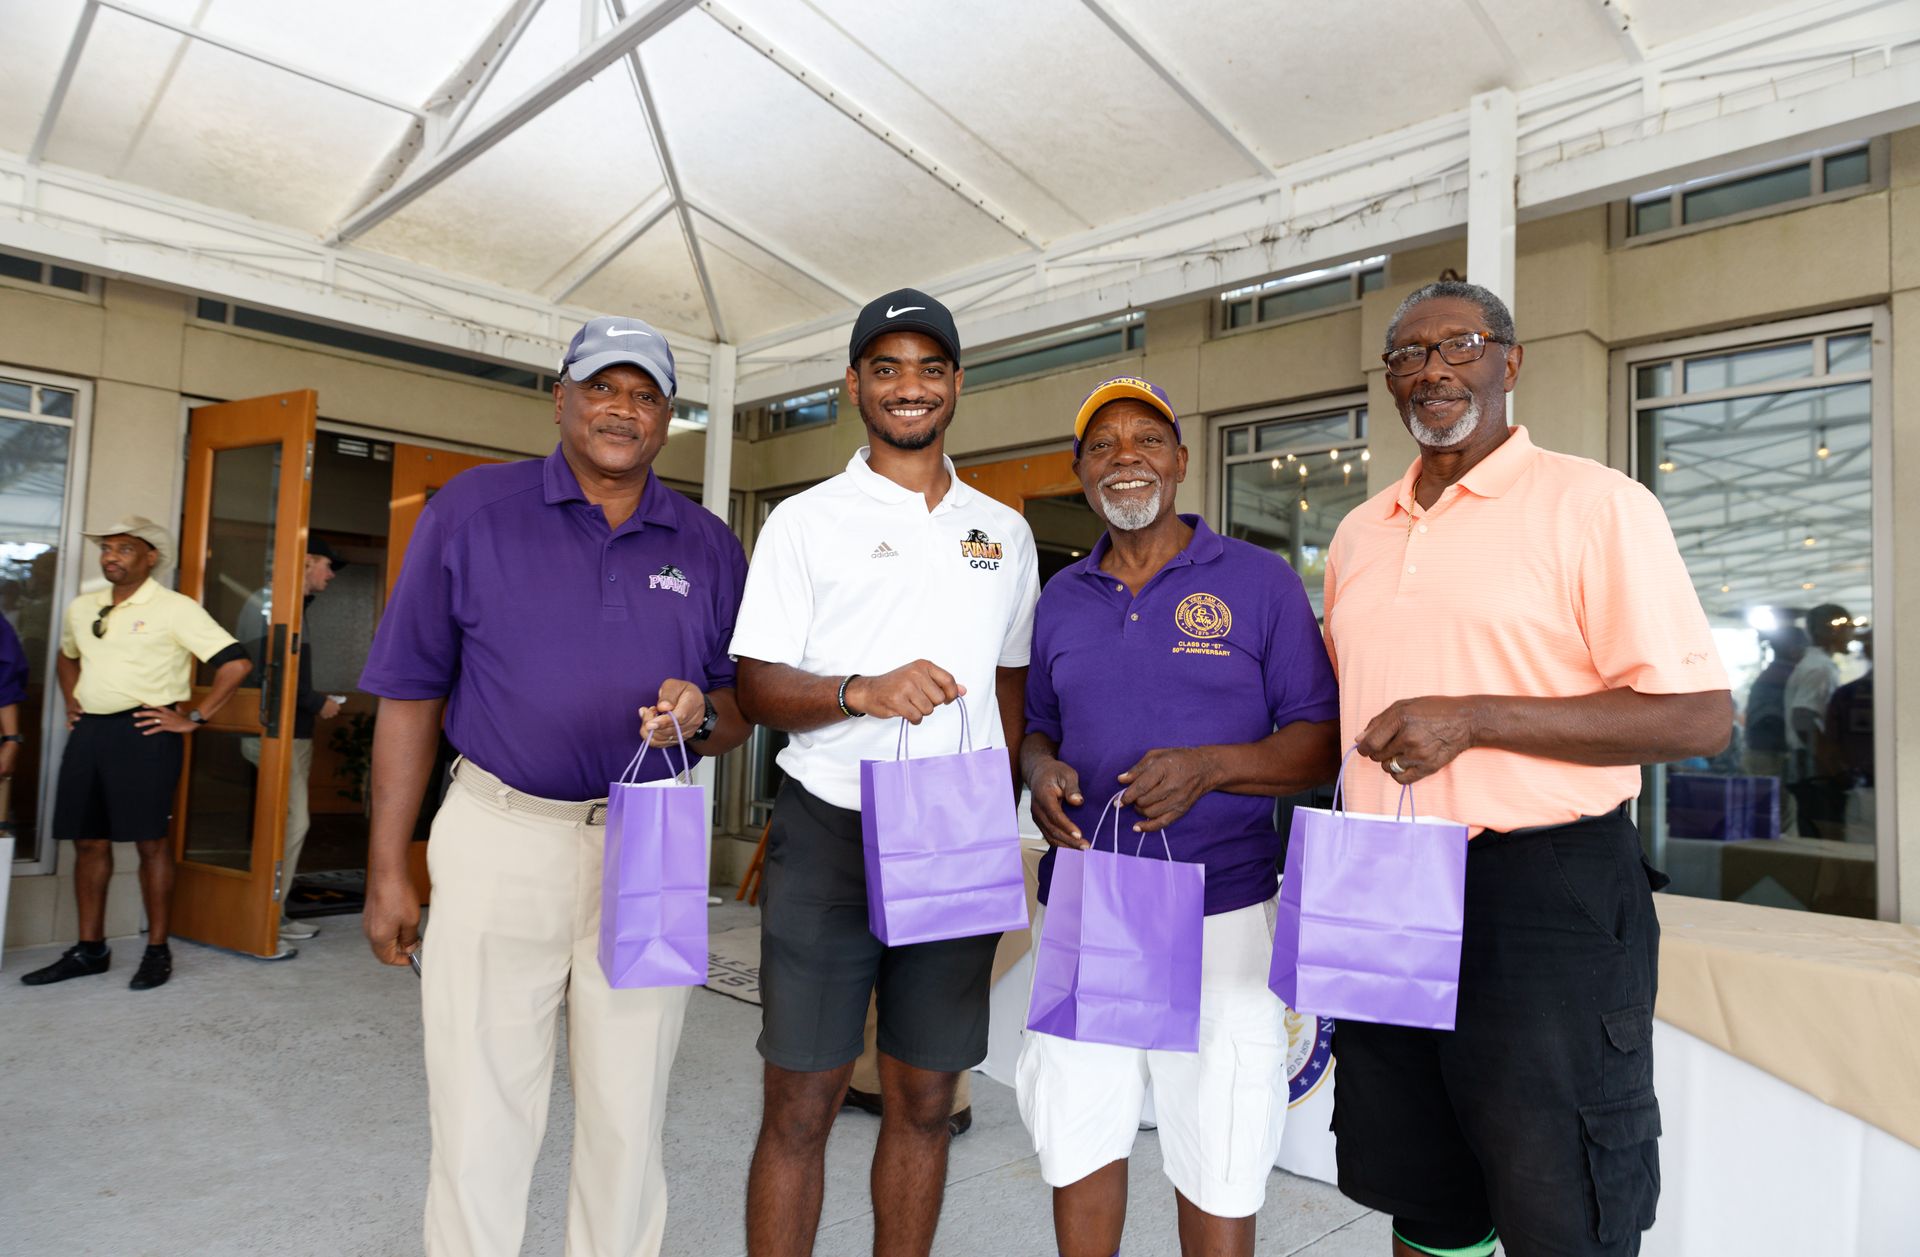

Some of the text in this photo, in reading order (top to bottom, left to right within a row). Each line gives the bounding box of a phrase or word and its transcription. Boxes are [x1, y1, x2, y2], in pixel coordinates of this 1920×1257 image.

[871, 550, 899, 558] adidas
[960, 540, 1003, 560] PVAMU
[970, 560, 1000, 571] GOLF
[1185, 647, 1231, 656] ANNIVERSARY
